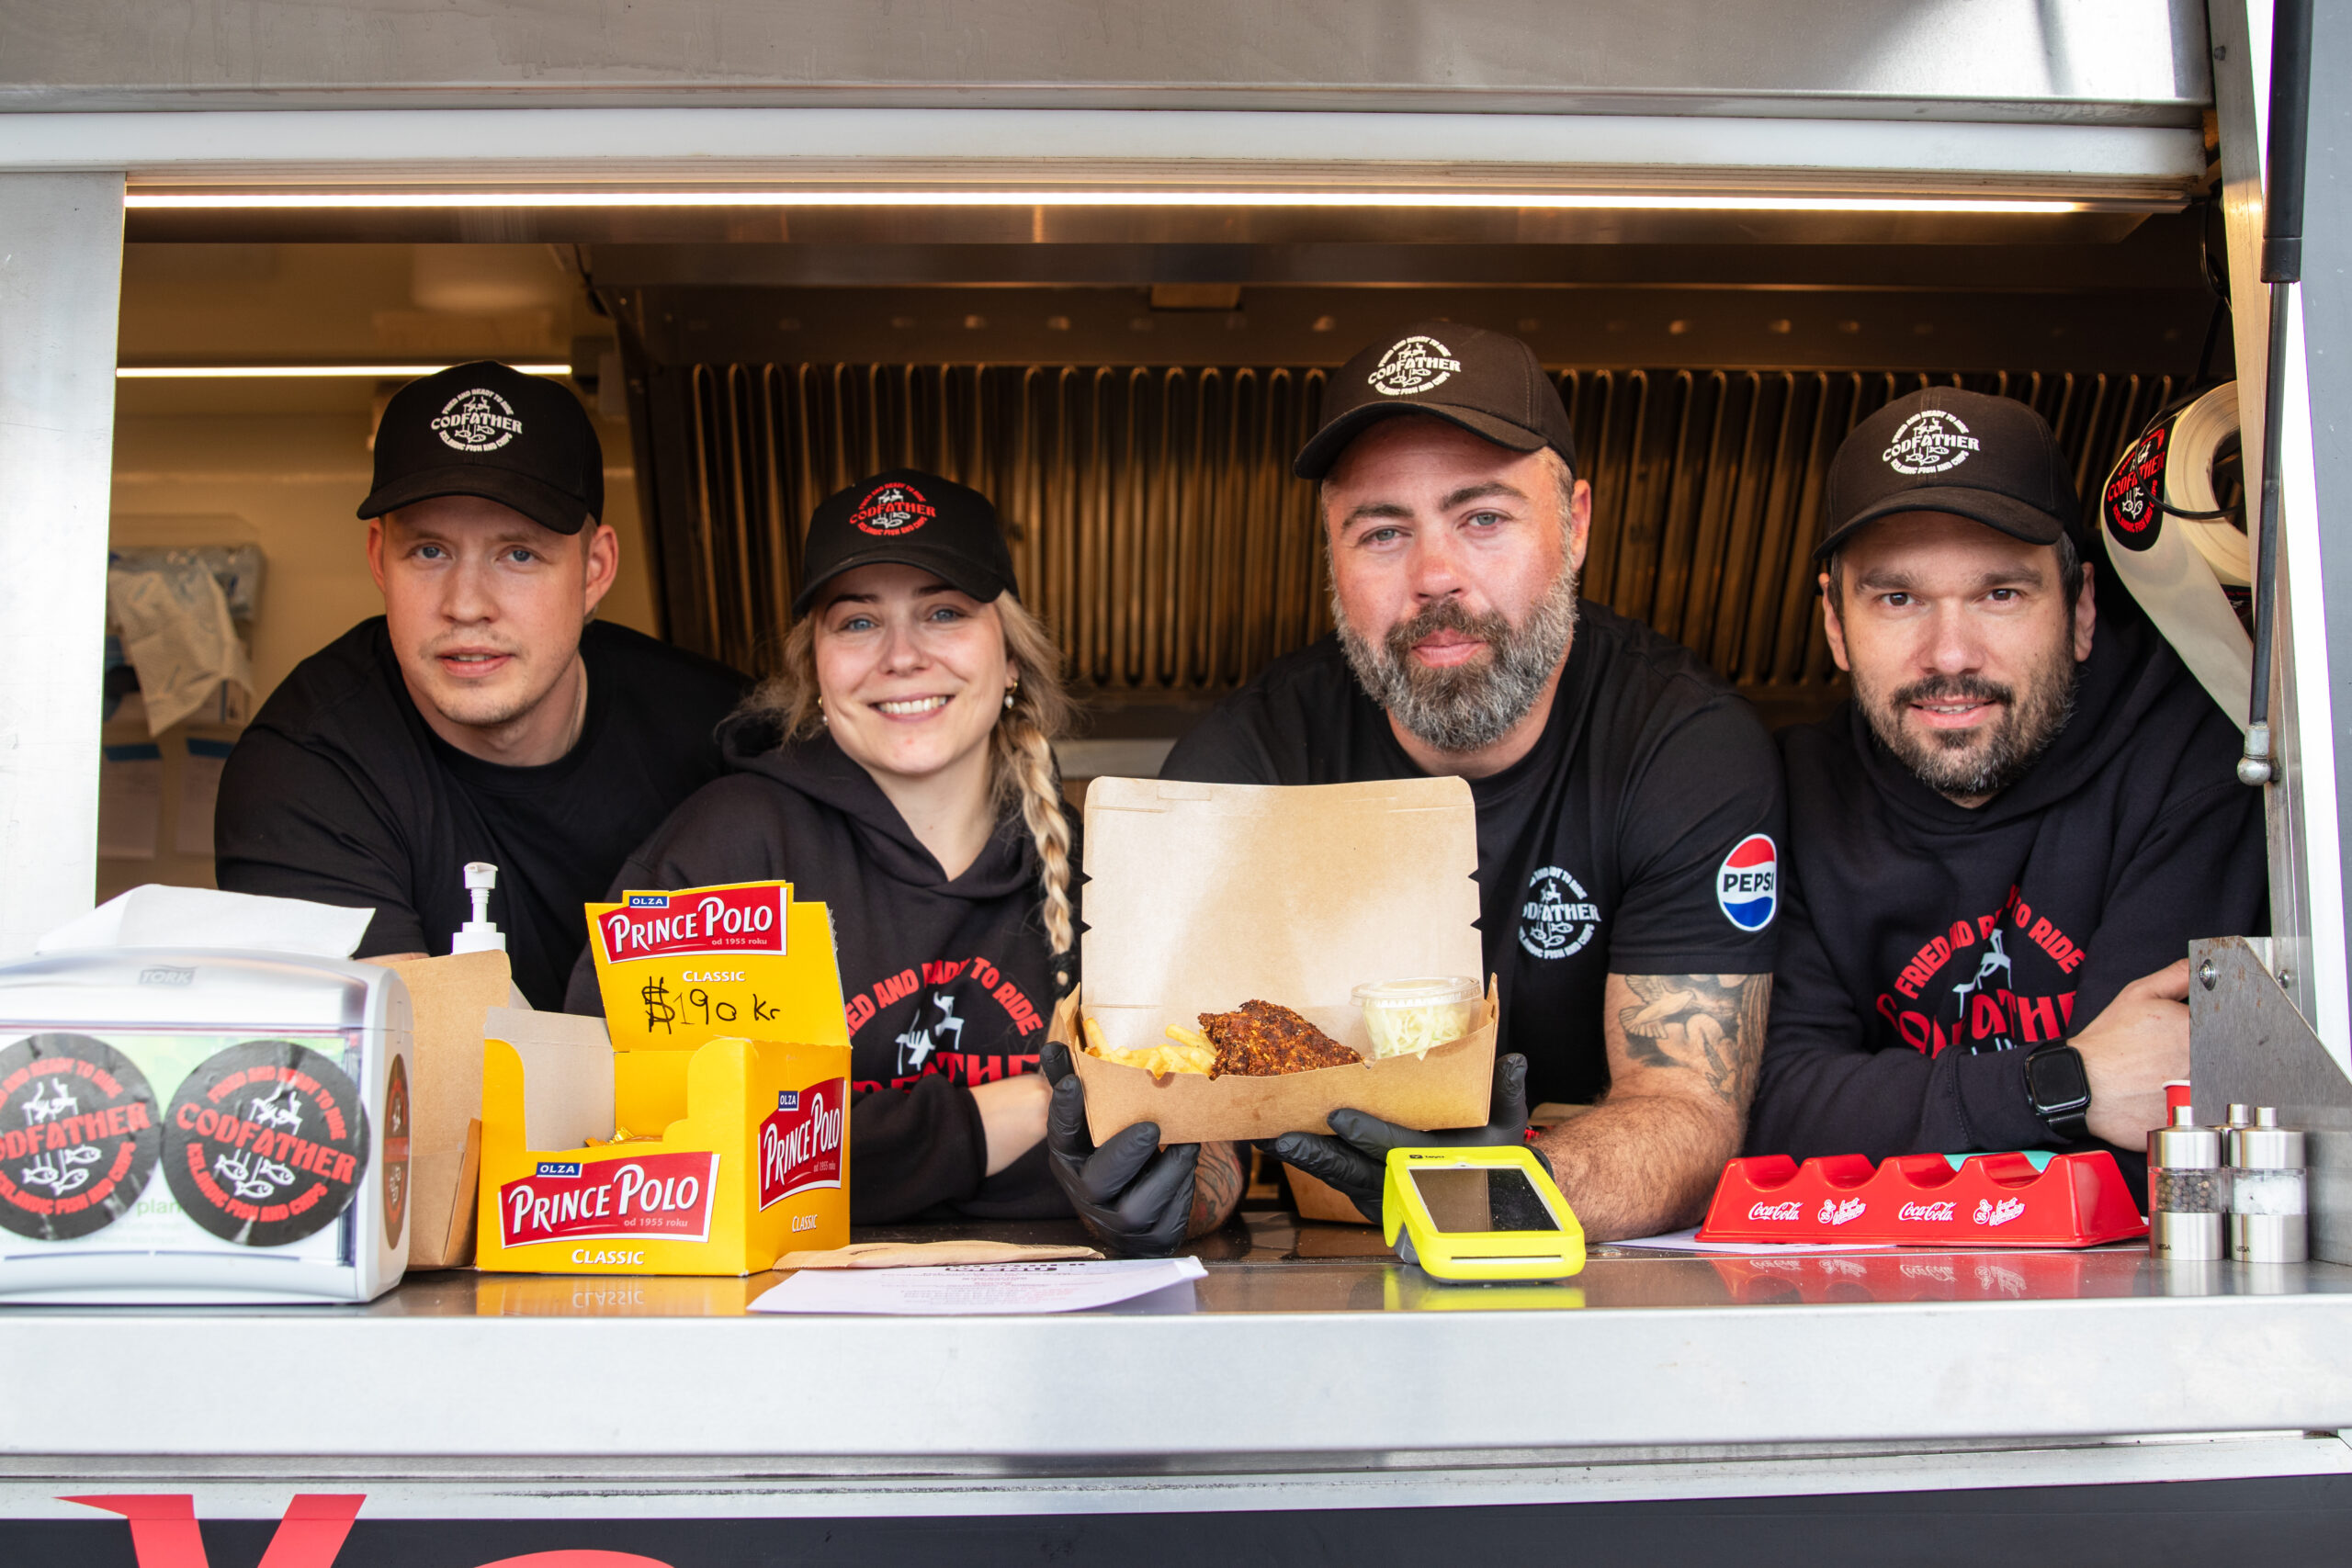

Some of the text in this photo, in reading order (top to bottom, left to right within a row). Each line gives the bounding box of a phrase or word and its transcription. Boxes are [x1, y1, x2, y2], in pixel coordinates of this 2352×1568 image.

[1368, 357, 1461, 384] CODFATHER
[431, 412, 523, 434] CODFATHER
[1882, 434, 1980, 462] CODFATHER
[849, 502, 936, 524] CODFATHER
[1723, 872, 1775, 893] PEPSI
[632, 897, 663, 906] OLZA
[1521, 902, 1602, 922] DFATHER
[607, 897, 773, 953] PRINCE POLO
[1894, 935, 1951, 1000] FRIED
[2028, 916, 2086, 975] RIDE
[142, 971, 191, 984] TORK
[683, 970, 746, 982] CLASSIC
[873, 968, 920, 1010] AND
[970, 956, 1000, 990] TO
[992, 981, 1044, 1037] RIDE
[780, 1095, 797, 1106] OLZA
[0, 1101, 152, 1162] DFATHER
[763, 1092, 841, 1191] PRINCE POLO
[176, 1102, 357, 1185] CODFATHER
[540, 1165, 575, 1175] OLZA
[509, 1164, 699, 1234] PRINCE POLO
[1748, 1201, 1803, 1221] Coca-Cola
[1898, 1201, 1957, 1221] Coca-Cola
[624, 1218, 688, 1227] od 1955 roku
[792, 1214, 818, 1233] CLASSIC
[571, 1248, 645, 1265] CLASSIC
